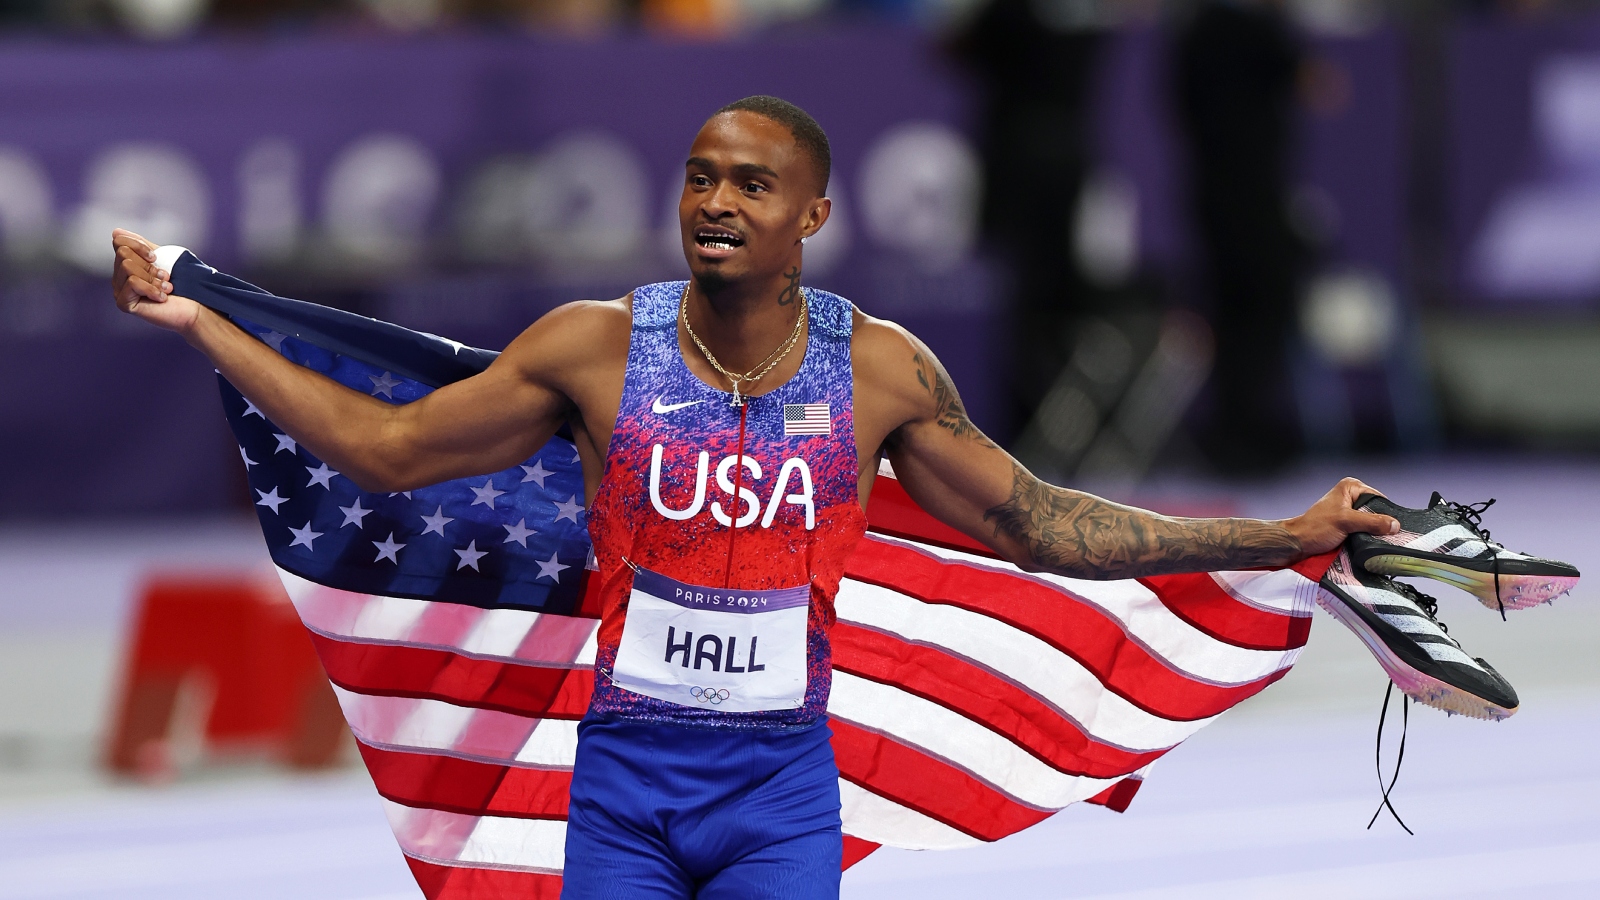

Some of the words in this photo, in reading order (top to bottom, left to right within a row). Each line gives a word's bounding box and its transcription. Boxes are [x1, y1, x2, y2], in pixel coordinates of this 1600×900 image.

[650, 444, 815, 530] USA
[727, 596, 767, 607] 2024
[665, 626, 765, 673] HALL
